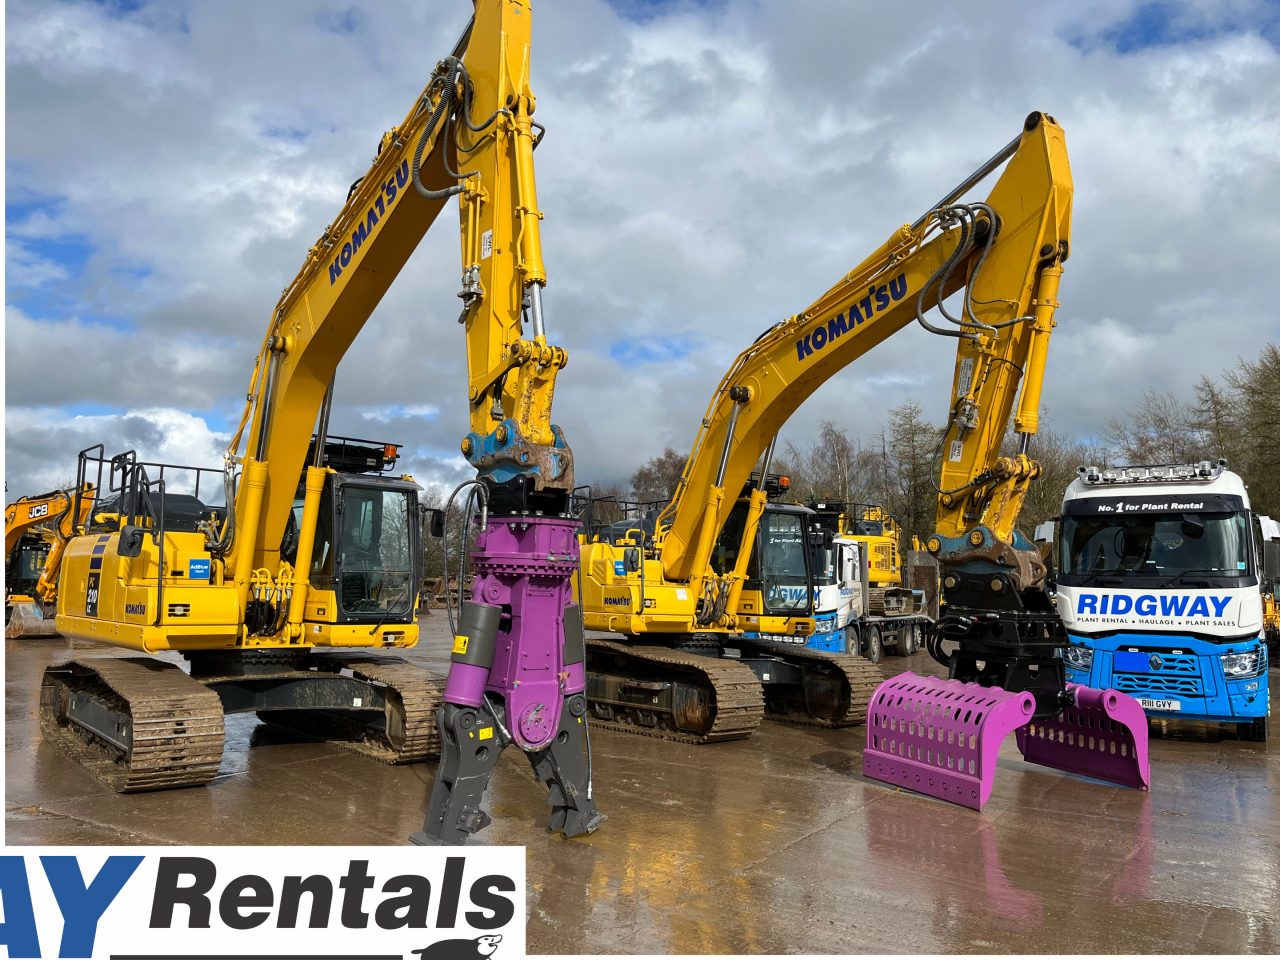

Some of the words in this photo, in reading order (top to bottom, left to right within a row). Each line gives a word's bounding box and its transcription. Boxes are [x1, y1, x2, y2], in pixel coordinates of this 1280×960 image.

[328, 158, 409, 286] KOMATSU
[796, 273, 908, 362] KOMATSU
[29, 504, 48, 518] JCB
[1098, 504, 1114, 512] No.
[1115, 502, 1124, 513] 1
[1125, 503, 1140, 511] for
[1142, 503, 1169, 511] Plant
[1171, 502, 1204, 510] Rental
[604, 596, 630, 606] KOMATSU
[1077, 594, 1233, 617] RIDGWAY
[125, 602, 146, 615] KOMATSU
[1156, 700, 1172, 708] GVY
